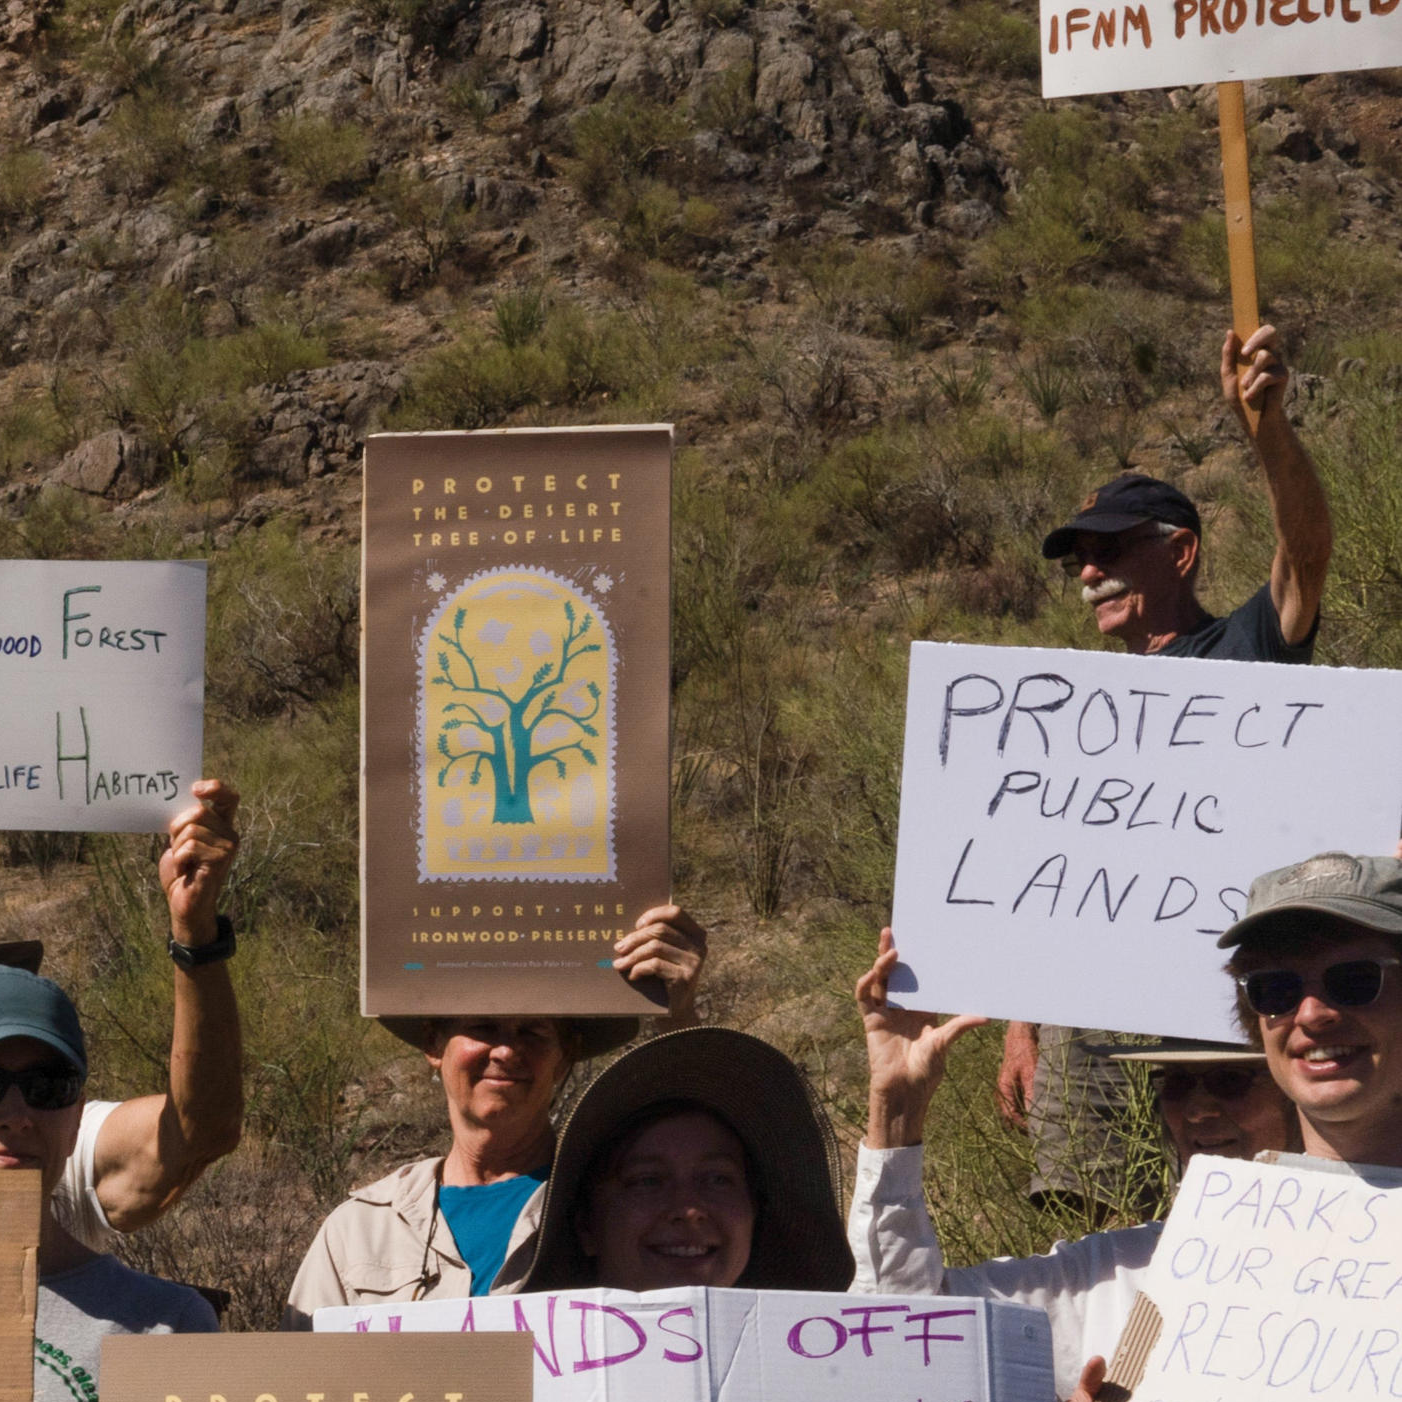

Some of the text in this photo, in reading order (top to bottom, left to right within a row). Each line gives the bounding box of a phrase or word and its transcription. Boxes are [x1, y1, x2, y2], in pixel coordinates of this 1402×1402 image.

[1048, 4, 1152, 54] IFNM
[412, 473, 621, 495] PROTECT
[412, 502, 621, 521] THE DESERT
[412, 528, 621, 546] TREE OF LIFE
[62, 585, 168, 660] FOREST
[938, 672, 1324, 769] PROTECT
[56, 706, 181, 805] HABITATS
[987, 770, 1224, 834] PUBLIC
[412, 903, 624, 917] SUPPORT THE
[412, 929, 625, 943] IRONWOOD PRESERVE
[1193, 1170, 1389, 1244] PARKS
[1171, 1237, 1274, 1290] OUR
[353, 1295, 976, 1377] NDS OFF
